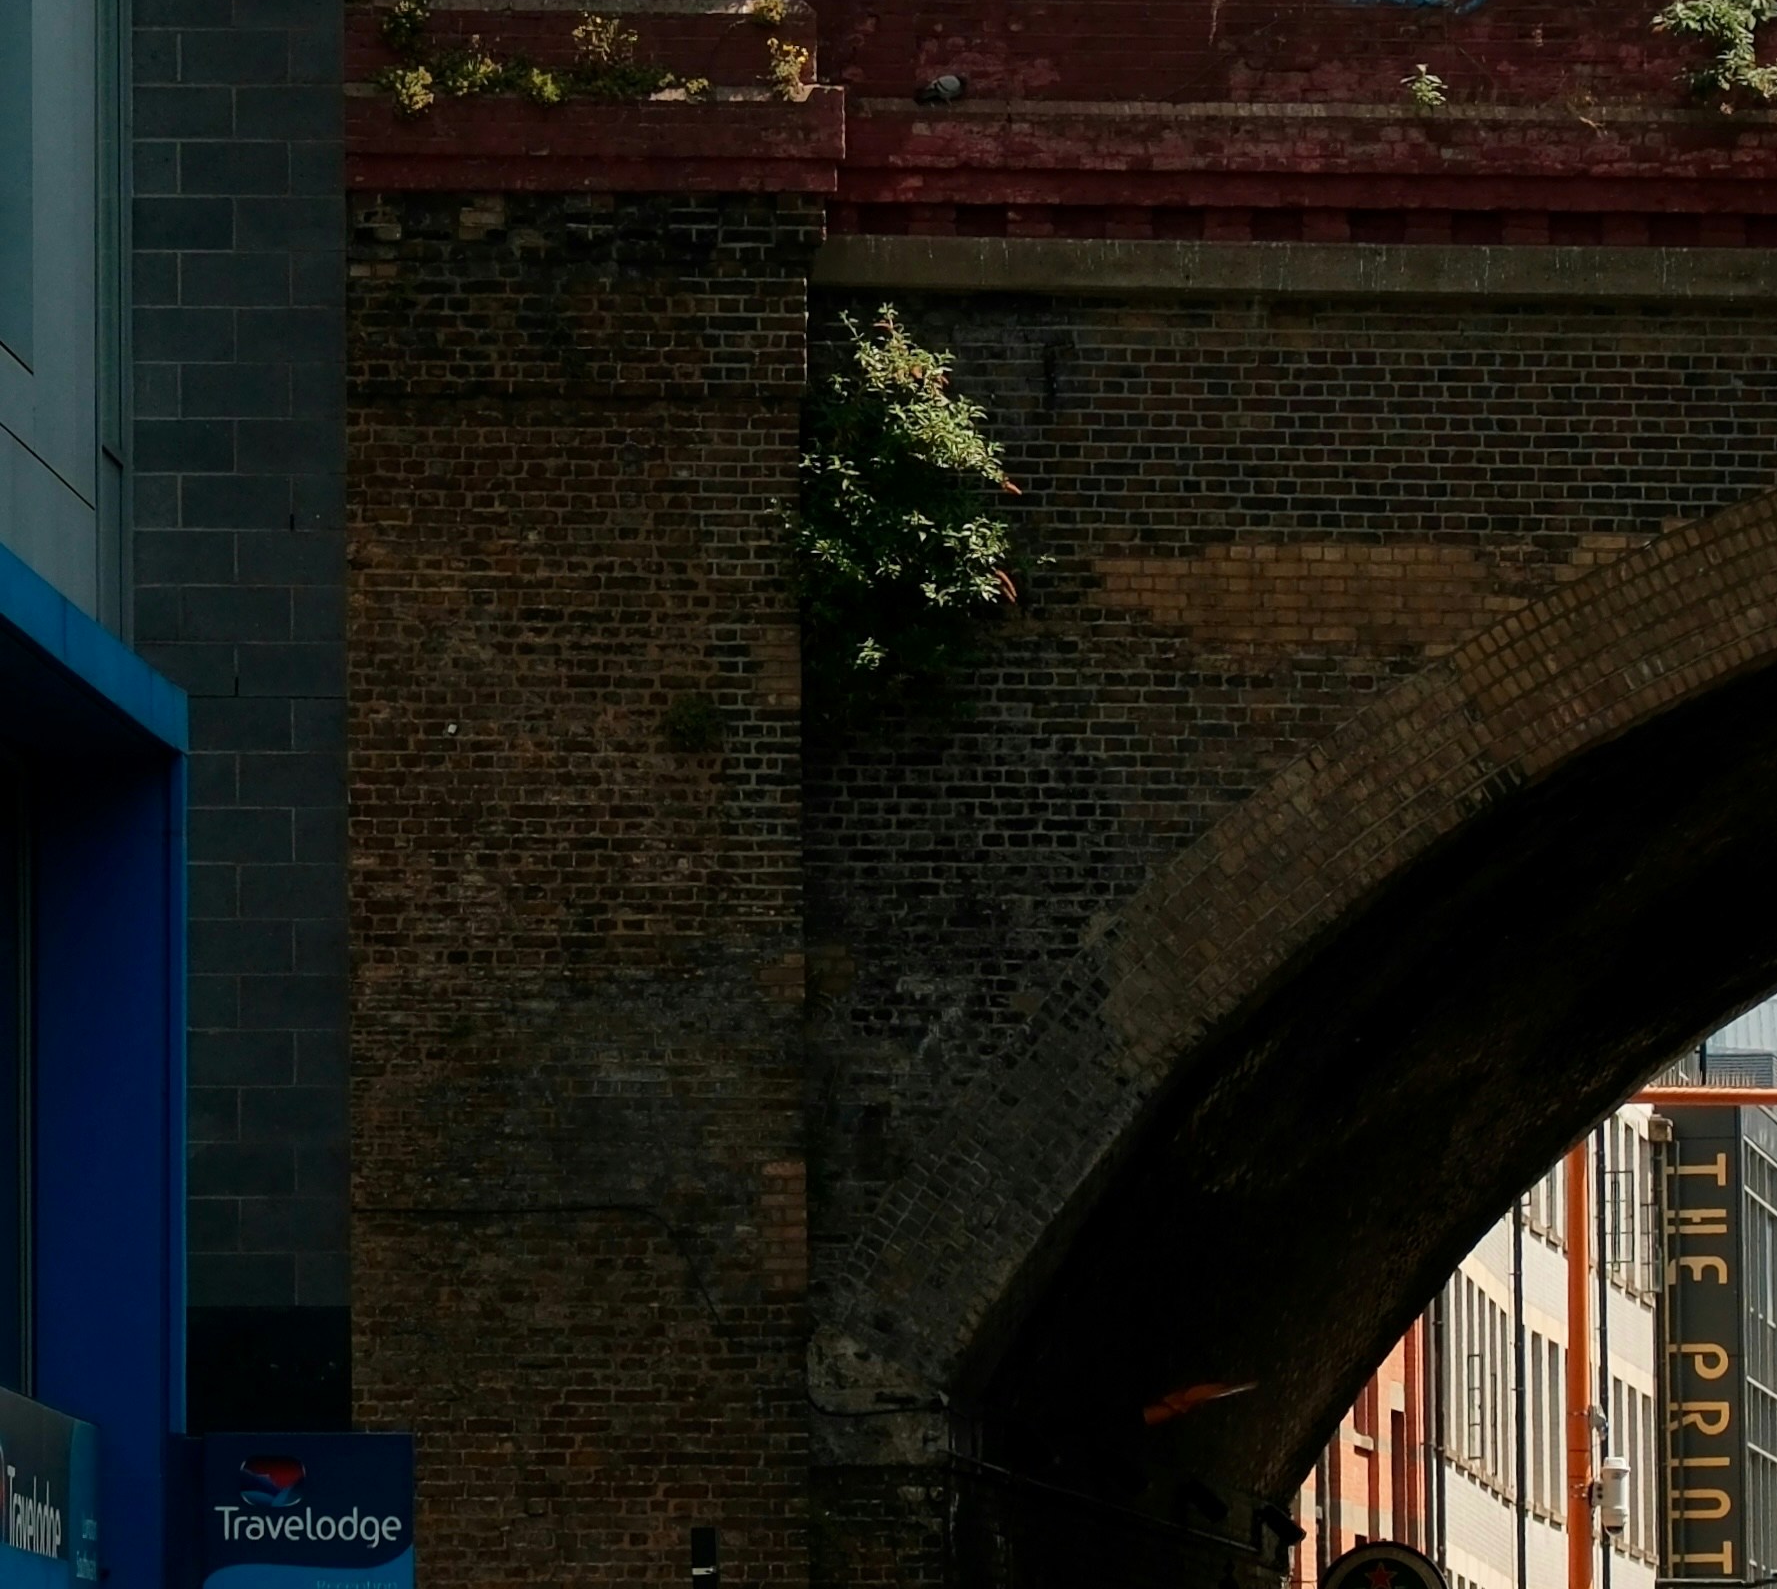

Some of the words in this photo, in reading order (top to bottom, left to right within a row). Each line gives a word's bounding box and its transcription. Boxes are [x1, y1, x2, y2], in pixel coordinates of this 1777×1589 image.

[1665, 1153, 1728, 1284] THE
[7, 1464, 62, 1559] Travelodge
[1668, 1343, 1732, 1575] PRINT
[214, 1505, 402, 1549] Travelodge
